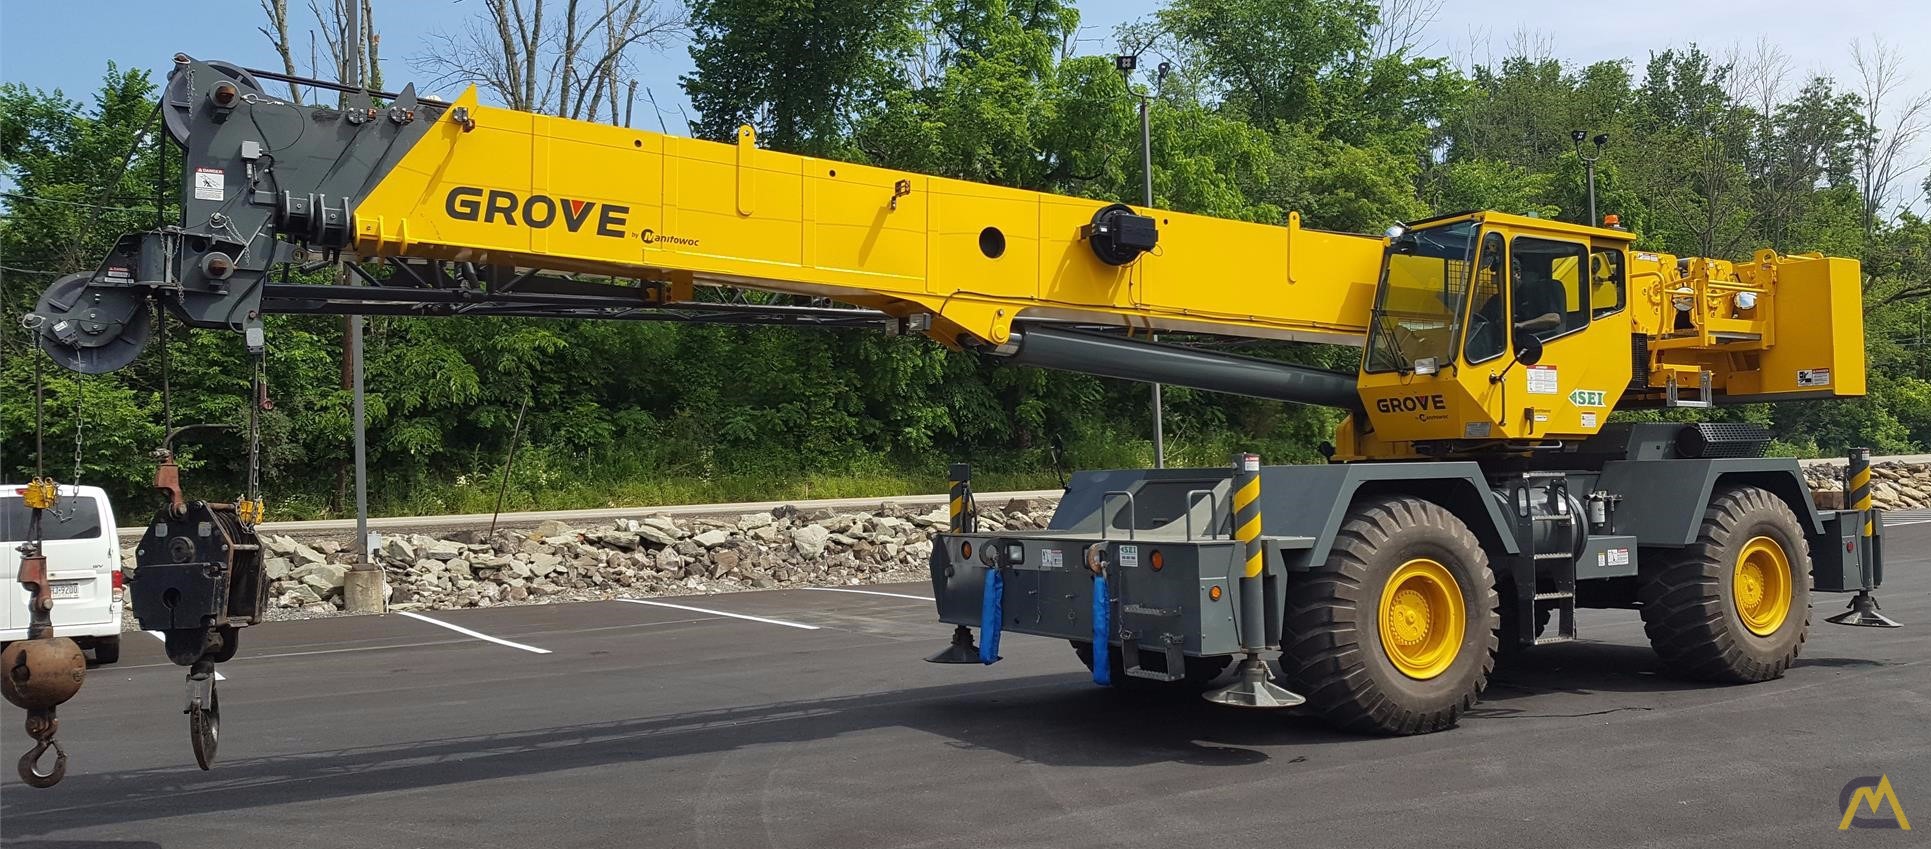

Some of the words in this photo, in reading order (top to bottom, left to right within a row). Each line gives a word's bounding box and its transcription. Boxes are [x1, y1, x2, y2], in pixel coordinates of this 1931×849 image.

[445, 186, 630, 238] GROVE
[641, 228, 700, 246] Manitowoc
[1376, 394, 1446, 413] GROVE
[1577, 391, 1604, 405] SEI
